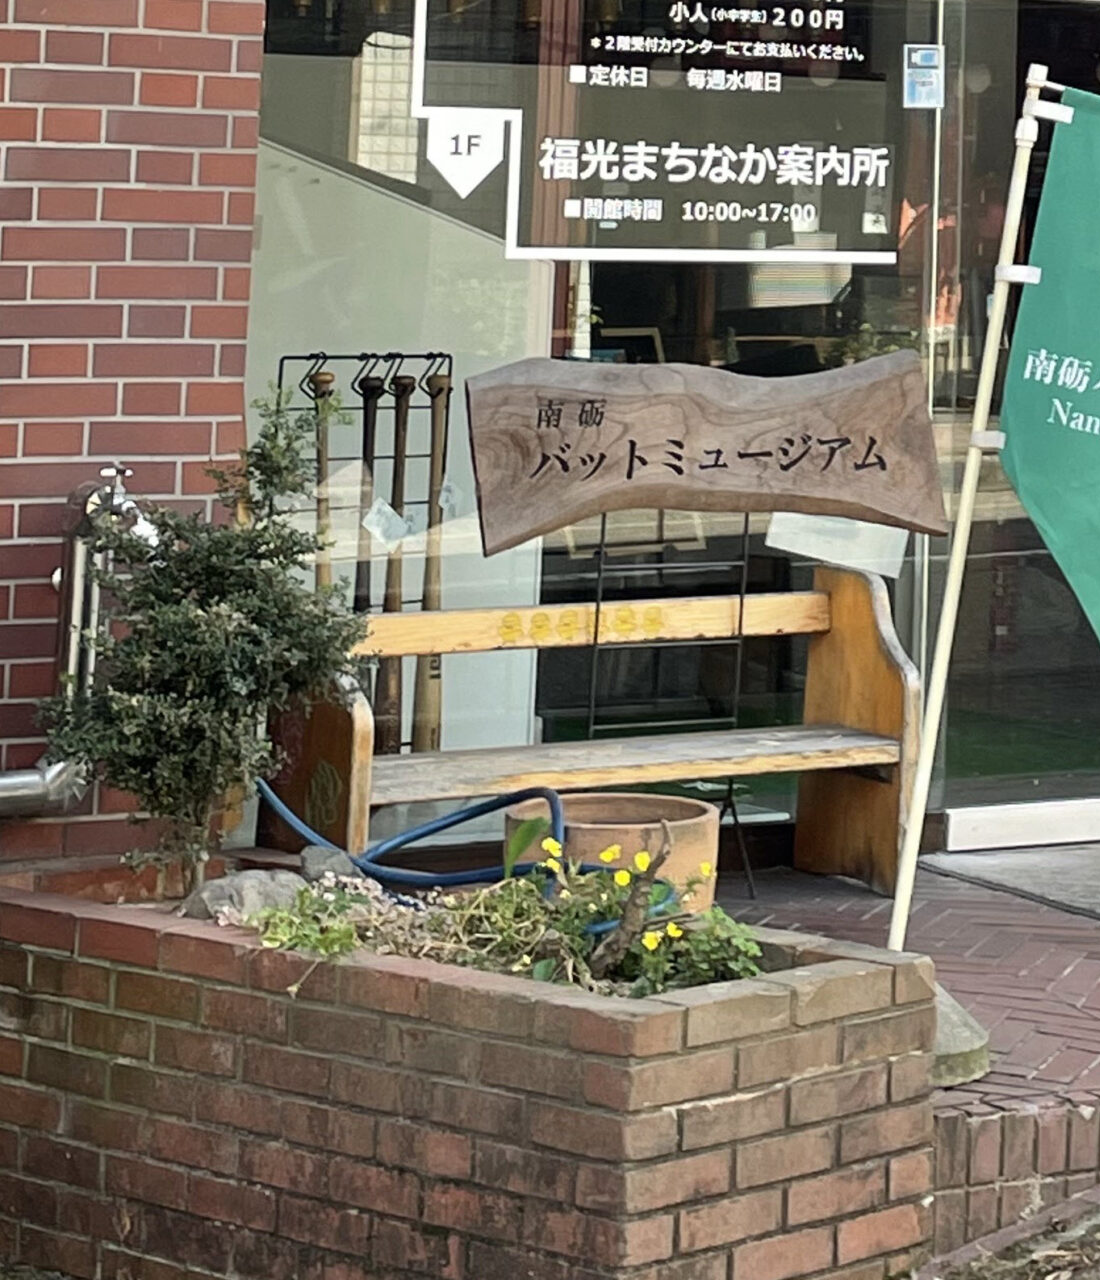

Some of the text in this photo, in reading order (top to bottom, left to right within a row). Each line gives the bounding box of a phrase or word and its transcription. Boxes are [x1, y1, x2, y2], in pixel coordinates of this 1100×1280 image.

[771, 7, 844, 31] 200円
[589, 65, 783, 93] 定休日 毎週水曜日
[449, 134, 482, 156] 1F
[539, 137, 890, 188] 福光まちなか案内所
[583, 197, 663, 222] 開館時間
[536, 398, 607, 430] 南砺
[529, 432, 889, 482] バットミュージアム
